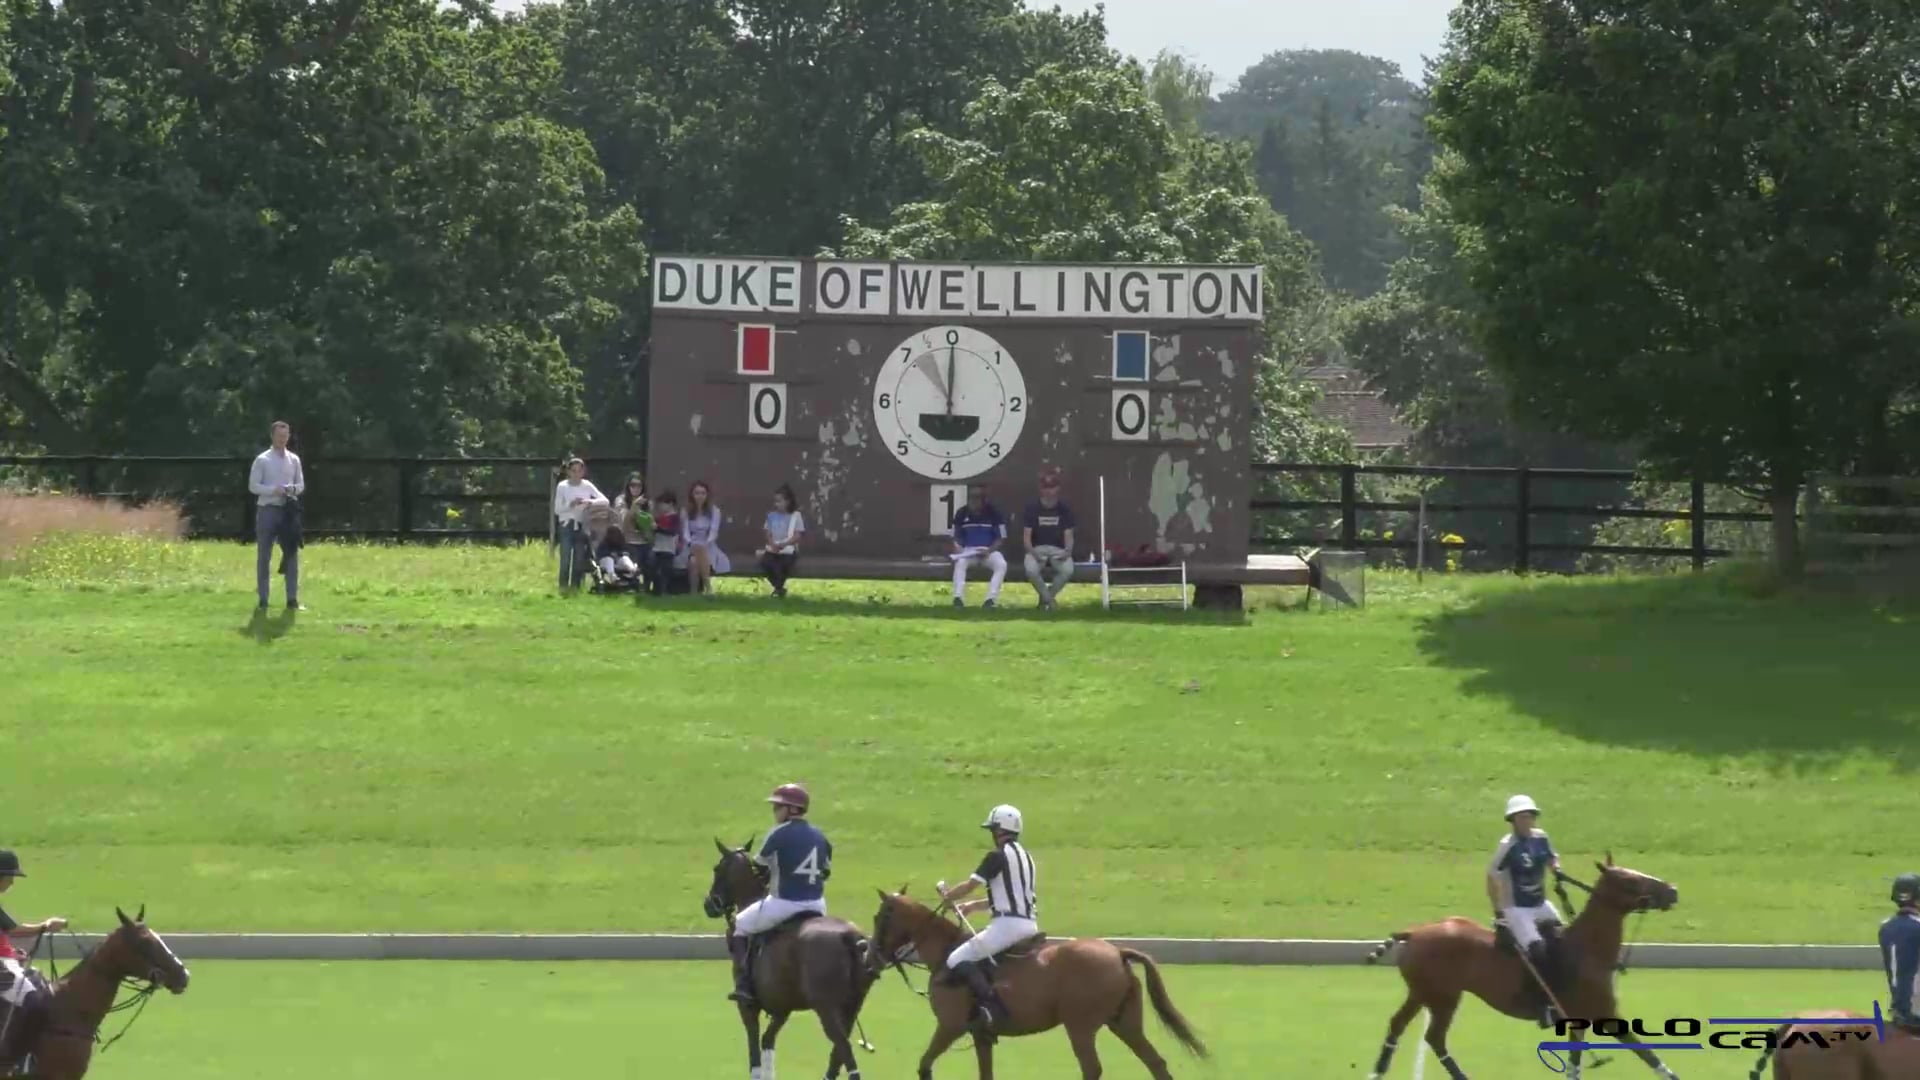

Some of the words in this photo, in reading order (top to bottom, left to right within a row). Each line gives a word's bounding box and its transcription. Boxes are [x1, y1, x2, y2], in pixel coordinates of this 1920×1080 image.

[658, 262, 794, 307] DUKE
[819, 266, 884, 309] OF
[900, 269, 1259, 314] WELLINGTON
[946, 329, 959, 345] 0
[900, 347, 912, 363] 7
[994, 350, 1001, 365] 1
[754, 387, 781, 430] 0
[879, 393, 890, 409] 6
[1009, 396, 1021, 412] 2
[1115, 393, 1145, 435] 0
[897, 440, 909, 456] 5
[988, 442, 1001, 458] 3
[939, 460, 953, 476] 4
[939, 489, 954, 530] 1
[793, 845, 821, 885] 4
[1520, 852, 1534, 868] 3
